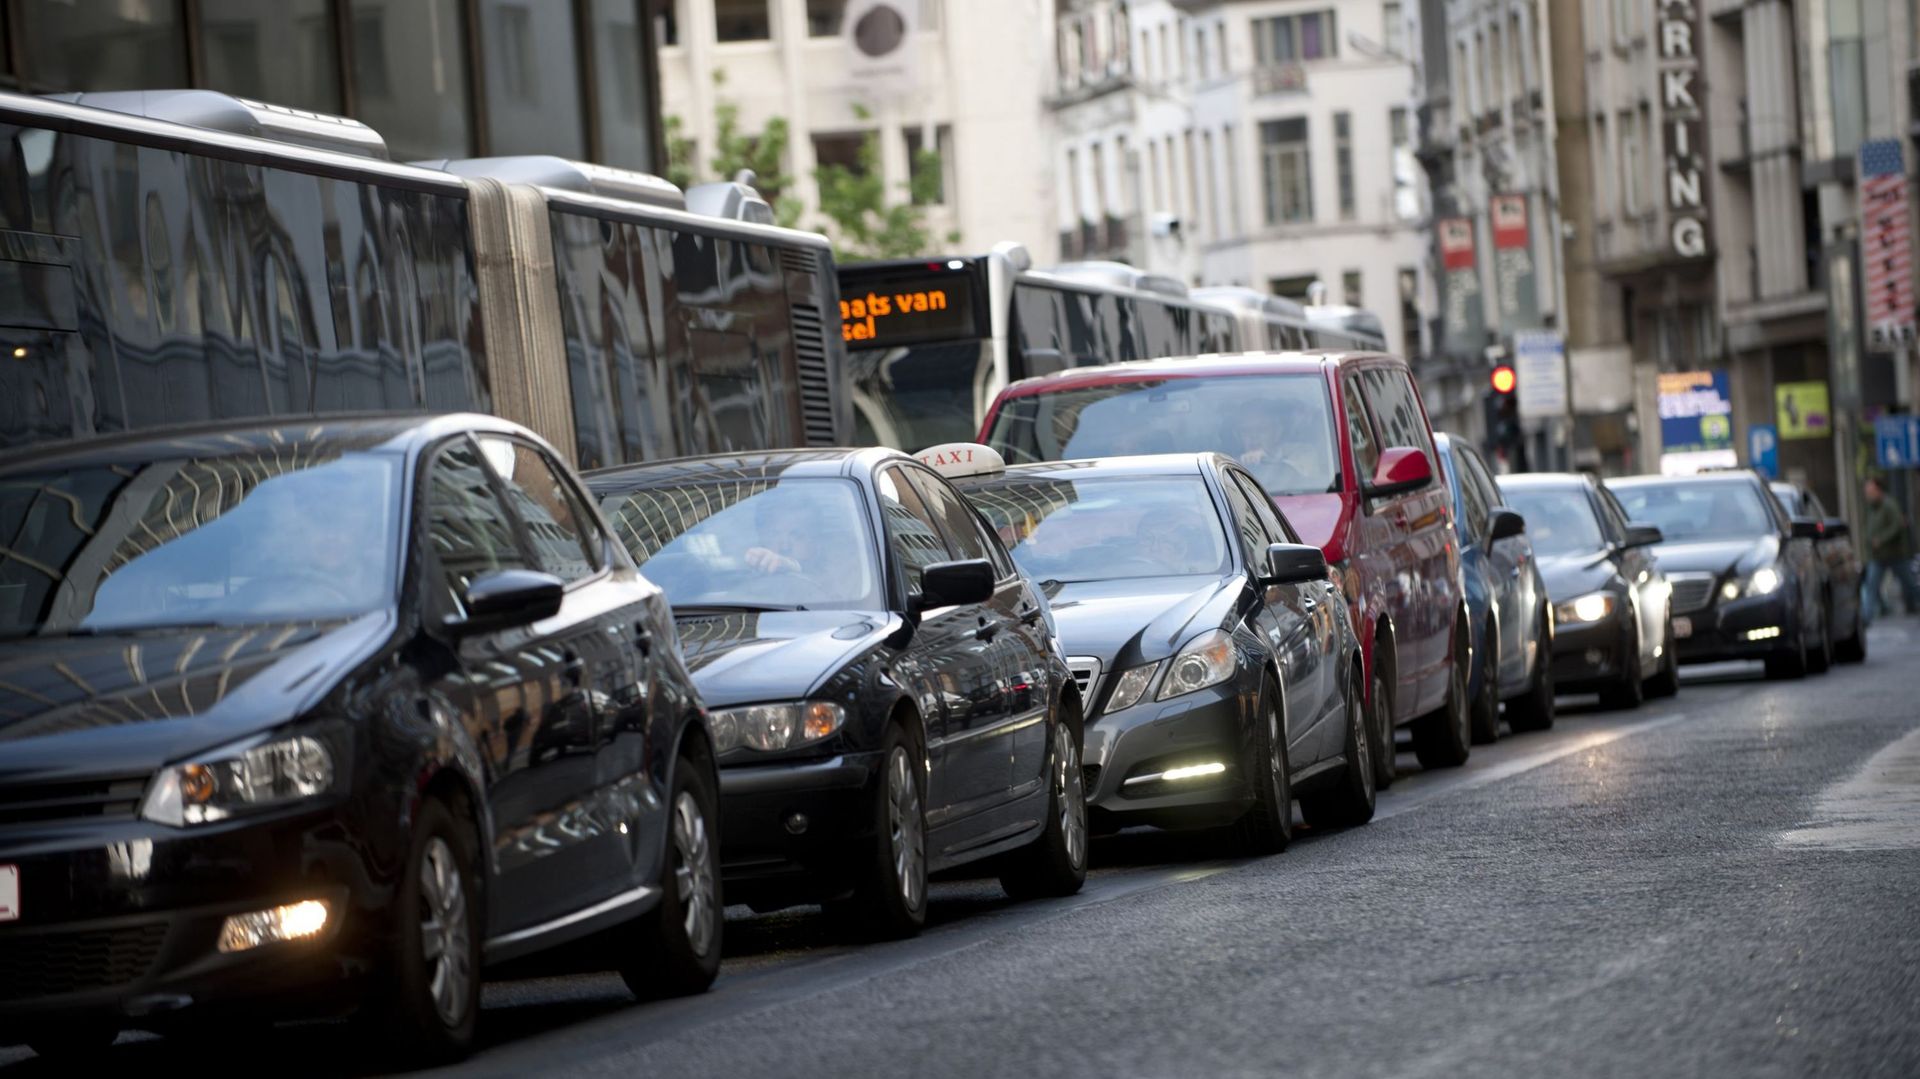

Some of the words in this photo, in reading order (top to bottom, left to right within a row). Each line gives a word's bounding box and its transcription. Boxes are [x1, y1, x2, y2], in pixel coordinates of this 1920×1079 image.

[1660, 0, 1706, 258] RKING
[895, 290, 947, 313] van
[919, 449, 974, 467] TAXI
[1751, 428, 1774, 464] P
